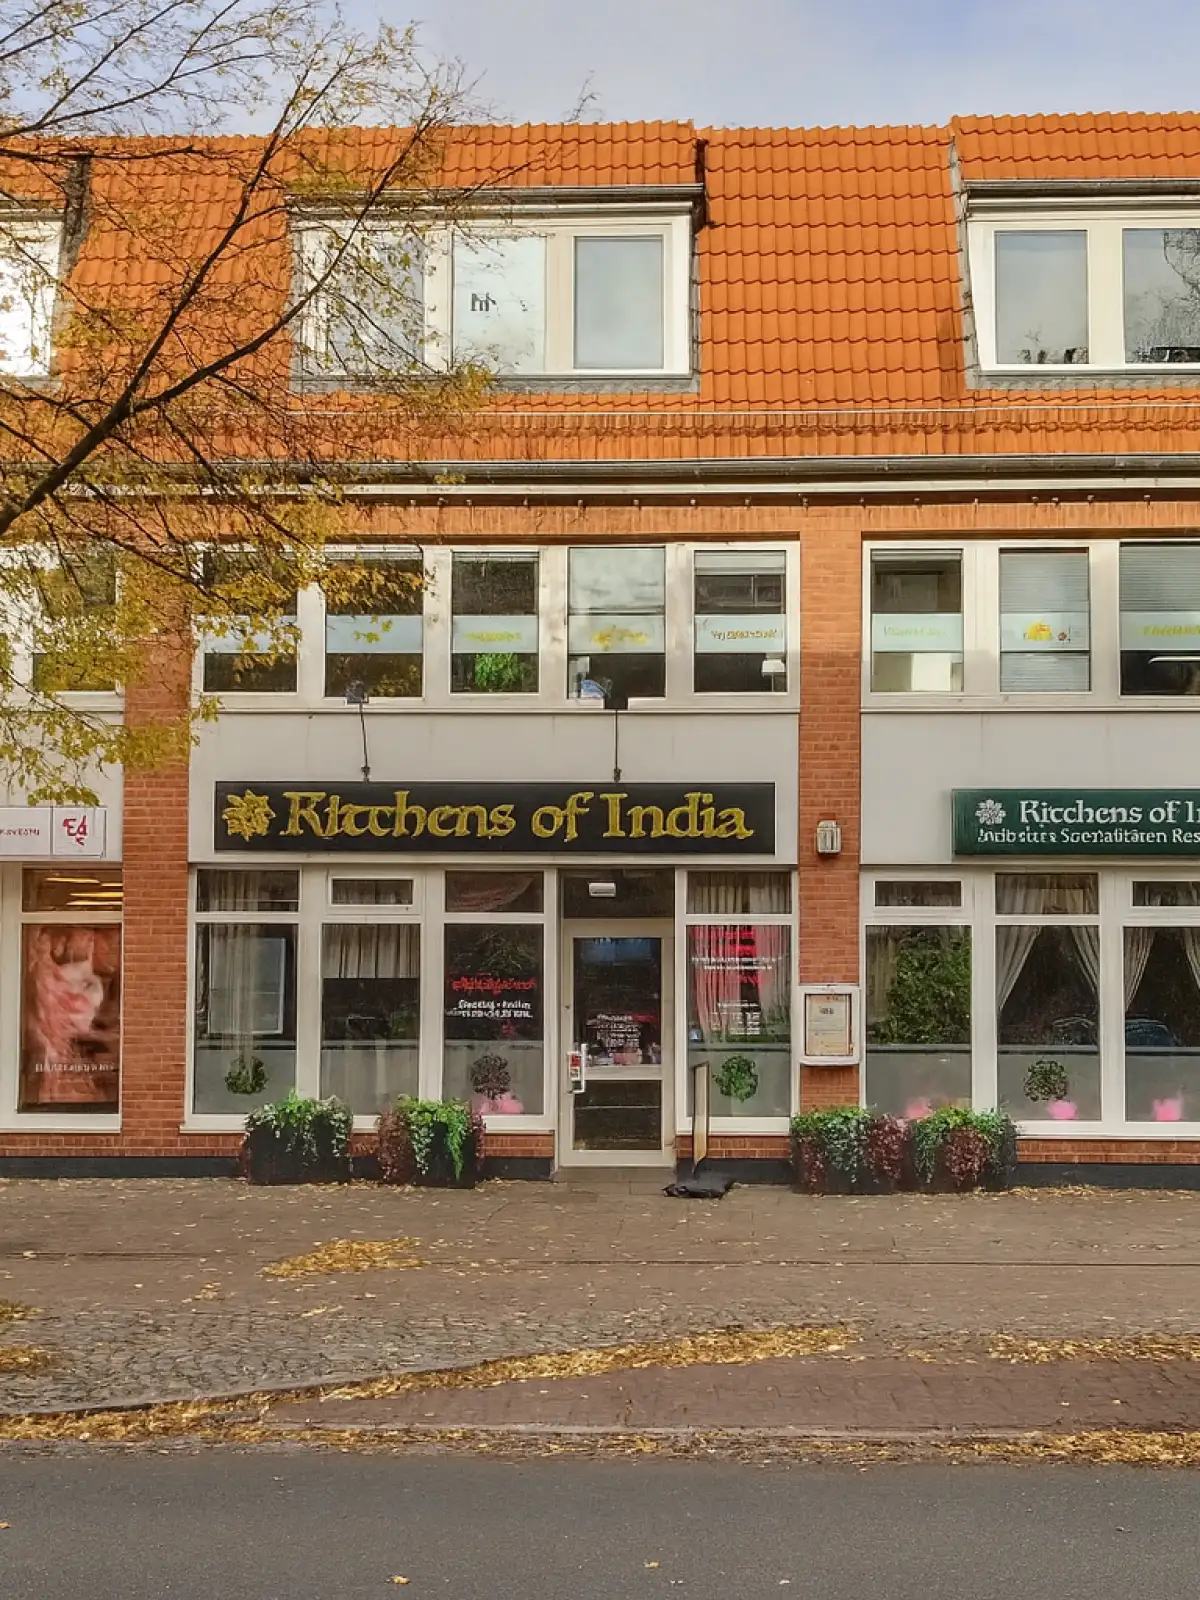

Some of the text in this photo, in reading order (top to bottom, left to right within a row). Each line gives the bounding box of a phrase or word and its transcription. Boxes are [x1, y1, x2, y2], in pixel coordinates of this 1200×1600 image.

[531, 791, 595, 842] of
[600, 791, 755, 840] India
[1149, 799, 1181, 823] of
